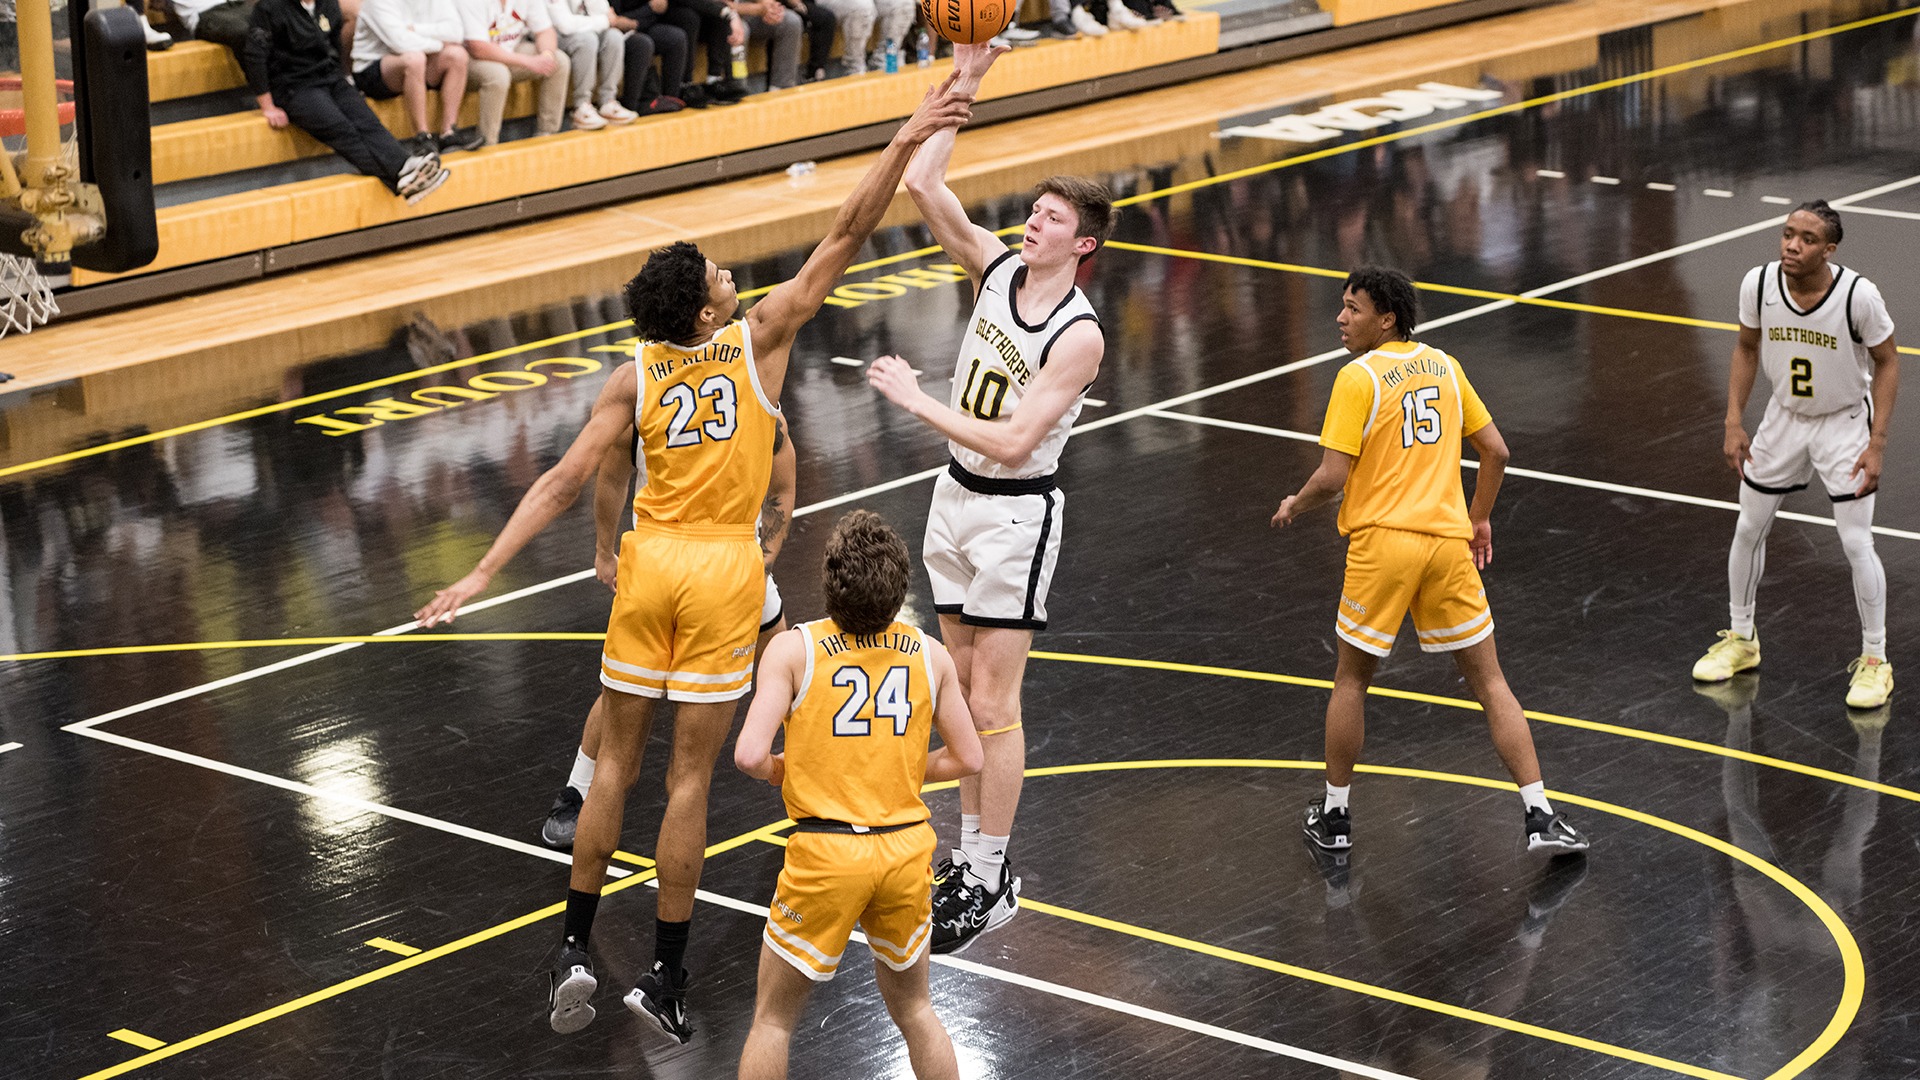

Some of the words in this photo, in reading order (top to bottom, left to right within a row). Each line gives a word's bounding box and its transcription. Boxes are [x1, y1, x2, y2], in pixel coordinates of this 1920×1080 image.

[1211, 81, 1503, 143] NCAA
[1768, 327, 1838, 350] OGLETHORPE
[294, 356, 603, 437] COURT
[960, 358, 1010, 421] 10
[1382, 366, 1404, 388] THE
[1790, 356, 1814, 398] 2
[660, 373, 738, 449] 23
[1401, 386, 1442, 449] 15
[819, 633, 852, 657] THE
[832, 666, 912, 737] 24
